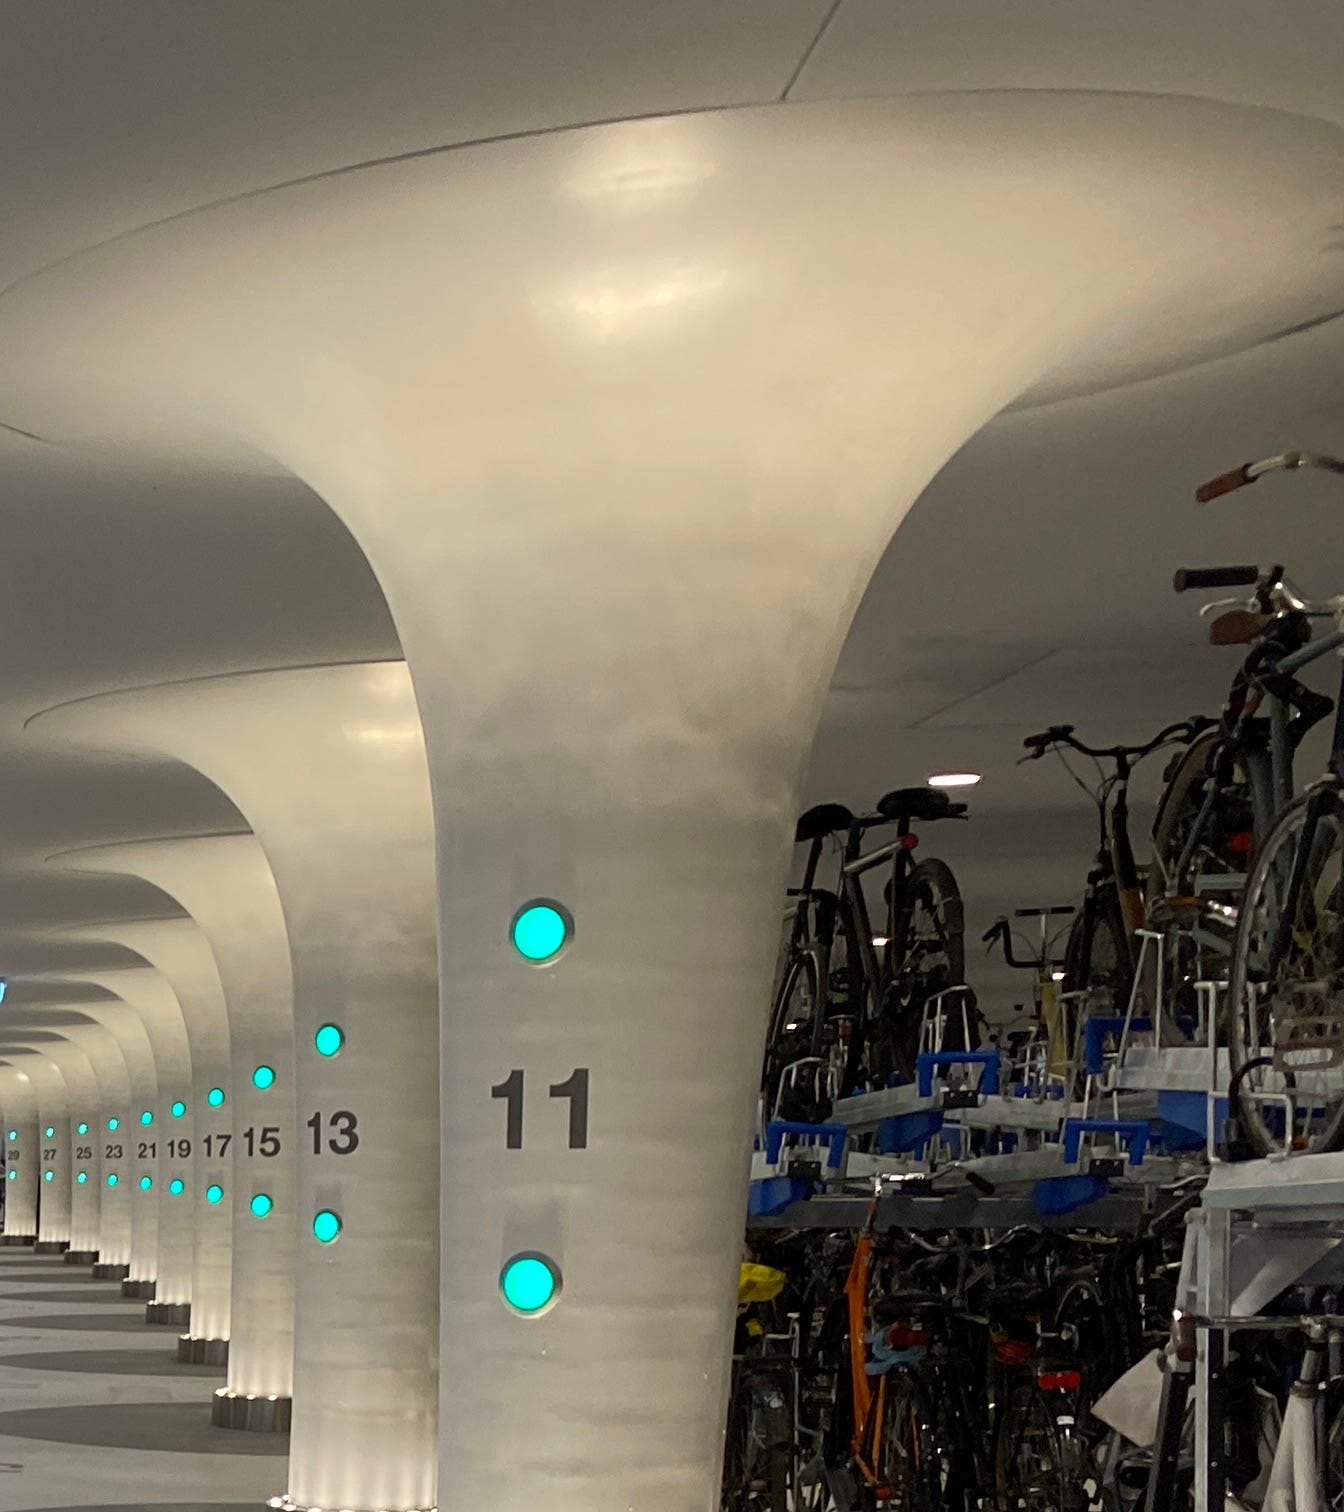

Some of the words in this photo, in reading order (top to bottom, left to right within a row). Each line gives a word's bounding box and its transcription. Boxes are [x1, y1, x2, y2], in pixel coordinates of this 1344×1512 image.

[492, 1068, 589, 1149] 11
[243, 1126, 281, 1158] 15
[308, 1111, 360, 1155] 13
[43, 1148, 57, 1161] 27
[76, 1146, 93, 1160] 25
[105, 1144, 124, 1160] 23
[137, 1142, 157, 1159] 21
[167, 1139, 192, 1159] 19
[203, 1134, 233, 1158] 17
[7, 1150, 20, 1161] 29
